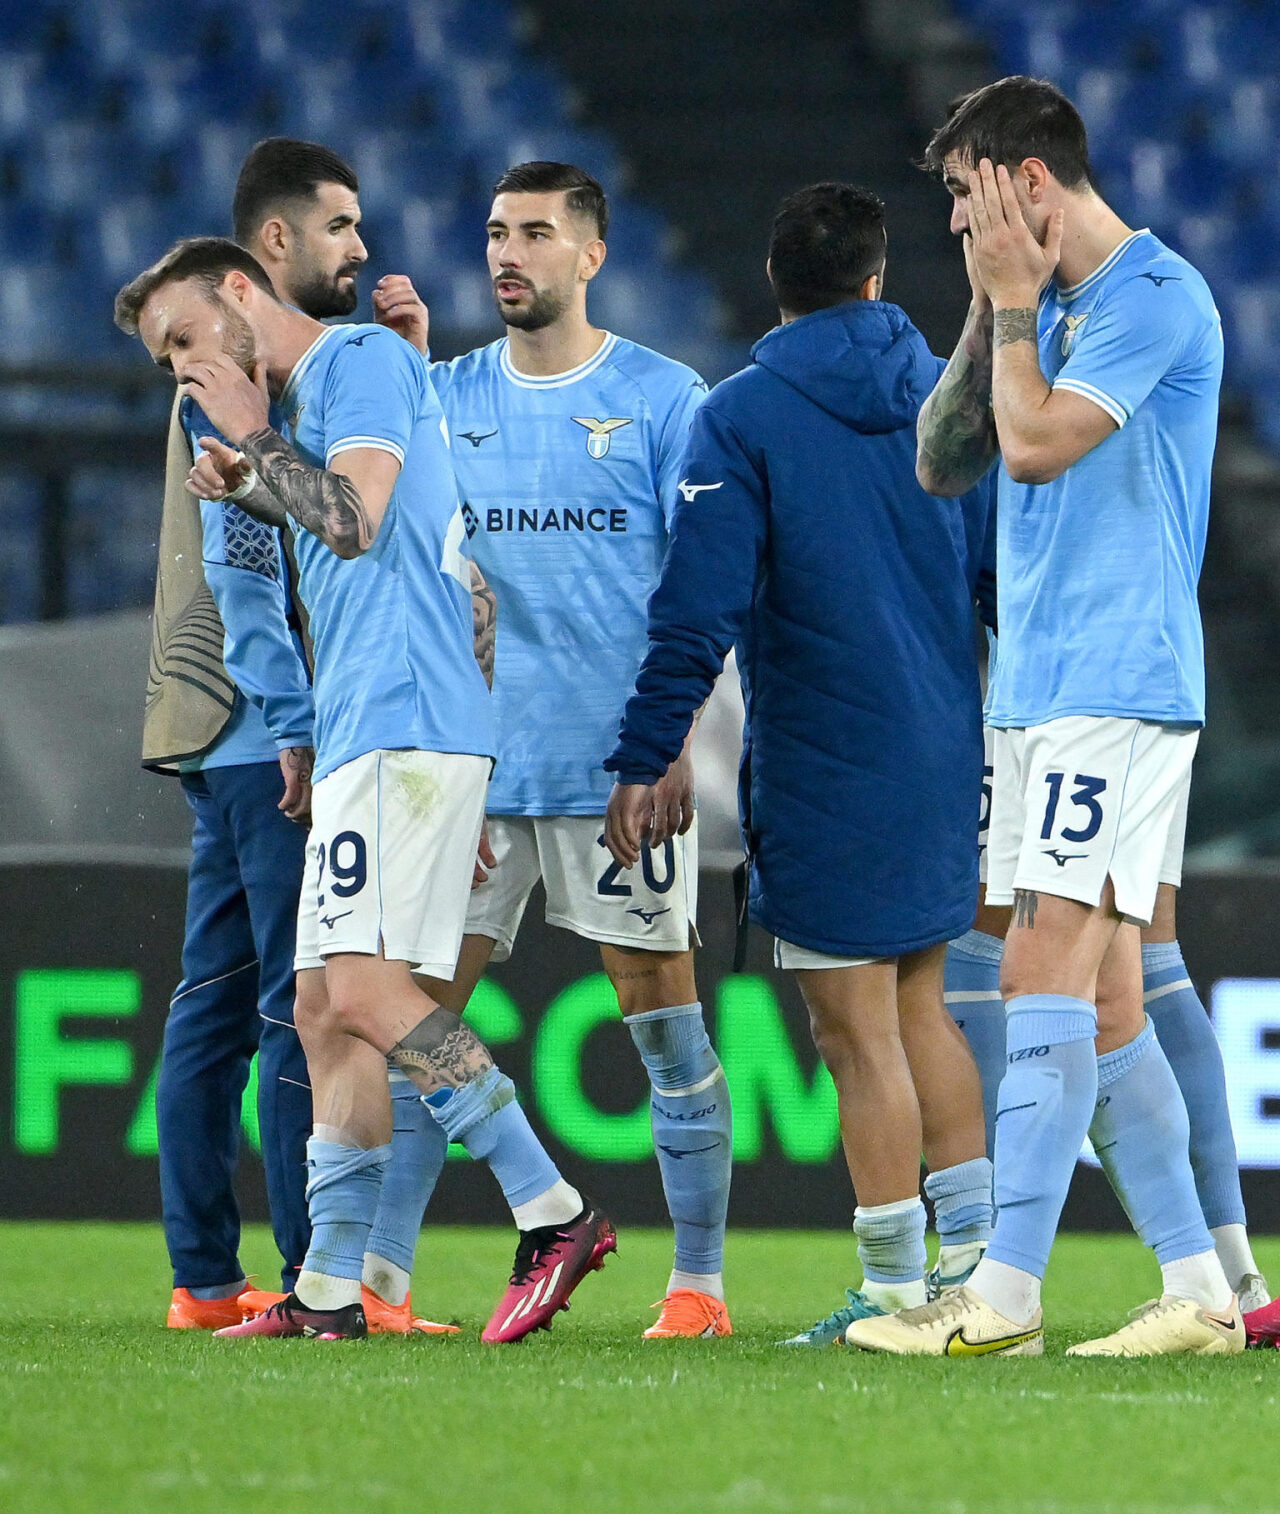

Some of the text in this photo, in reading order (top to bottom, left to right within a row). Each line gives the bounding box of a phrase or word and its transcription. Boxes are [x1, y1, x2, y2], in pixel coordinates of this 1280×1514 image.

[486, 507, 628, 533] BINANCE
[1040, 772, 1108, 843] 13
[596, 832, 676, 897] 20
